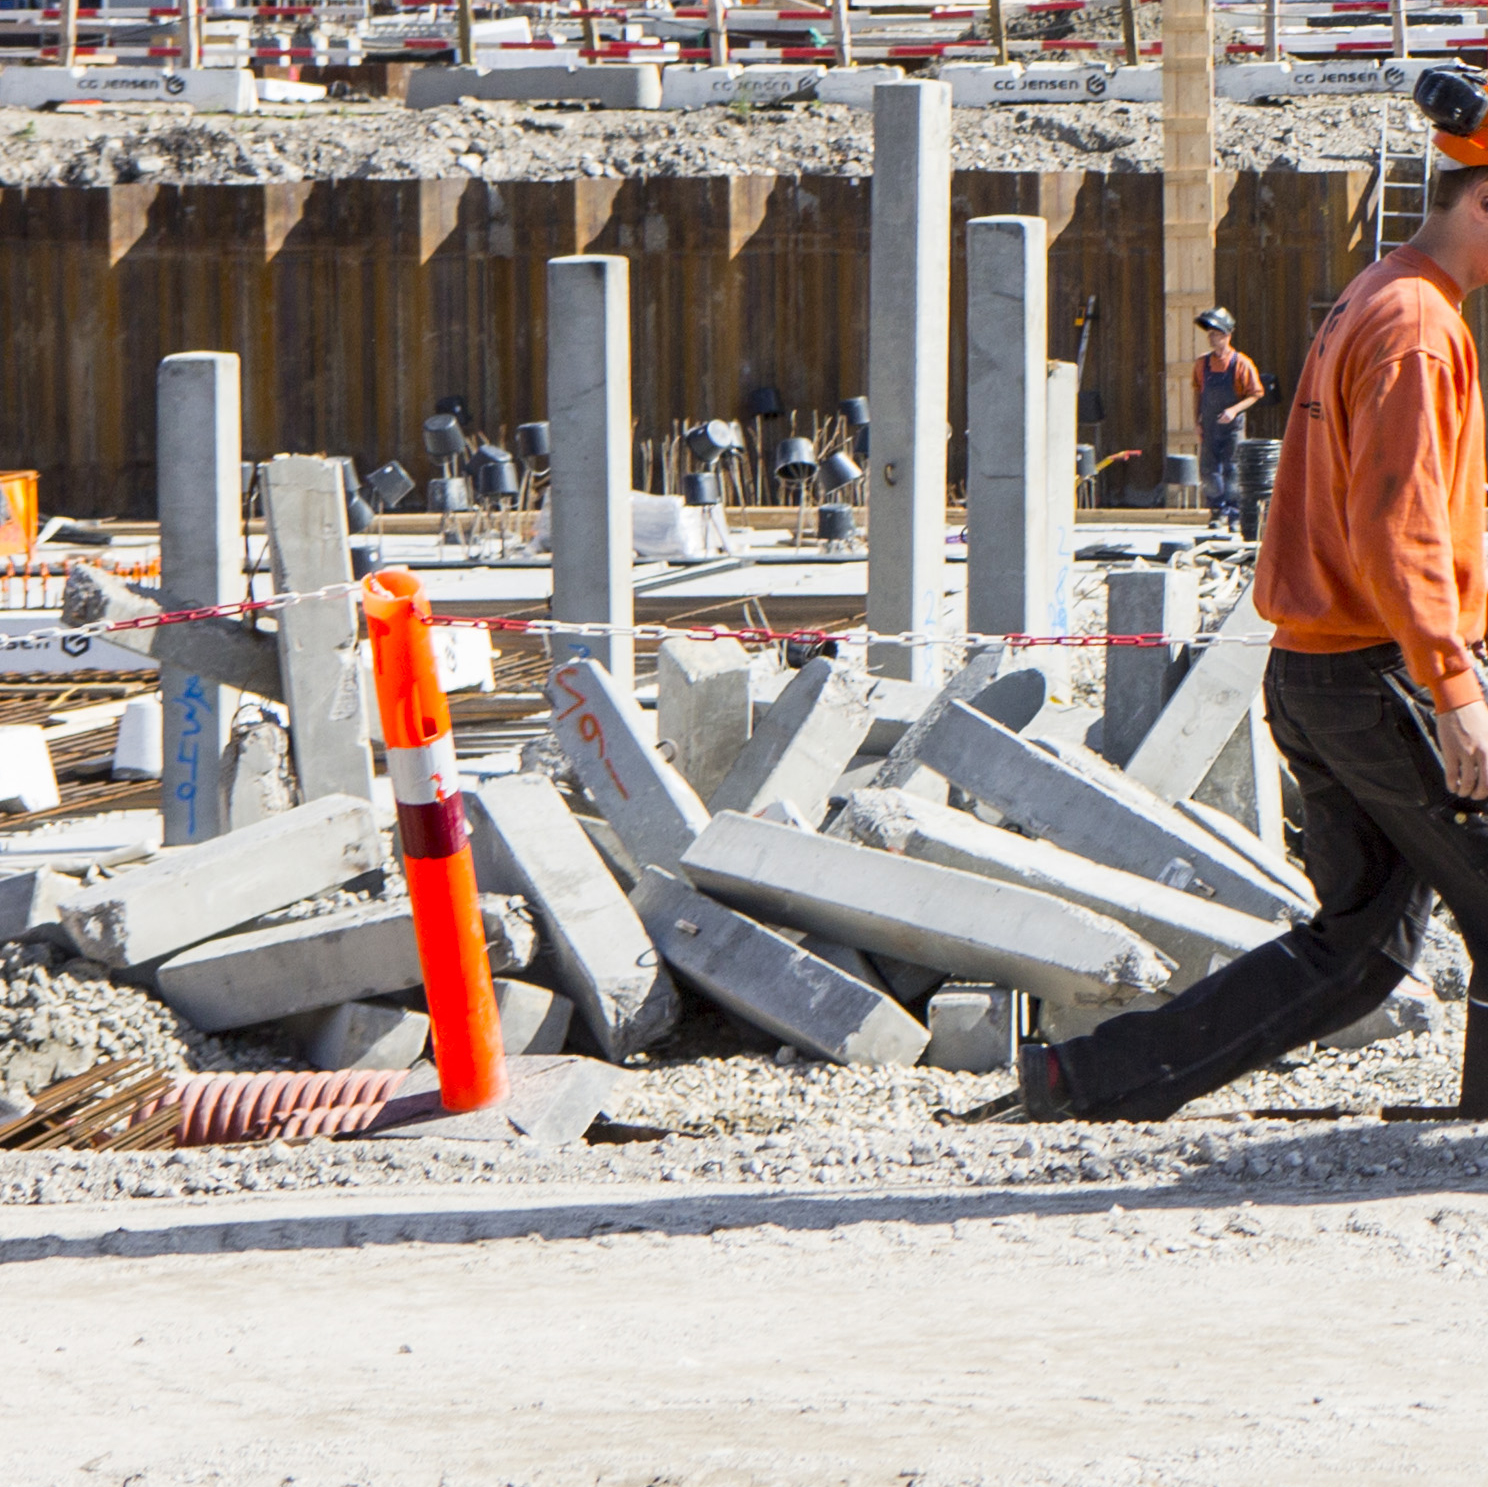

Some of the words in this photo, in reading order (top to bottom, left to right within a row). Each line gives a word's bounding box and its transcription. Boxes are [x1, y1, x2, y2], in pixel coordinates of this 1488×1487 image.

[1293, 73, 1315, 84] CG
[1319, 72, 1378, 83] JENSEN
[102, 79, 159, 89] JENSEN
[994, 80, 1015, 90] CG
[1020, 80, 1079, 90] JENSEN
